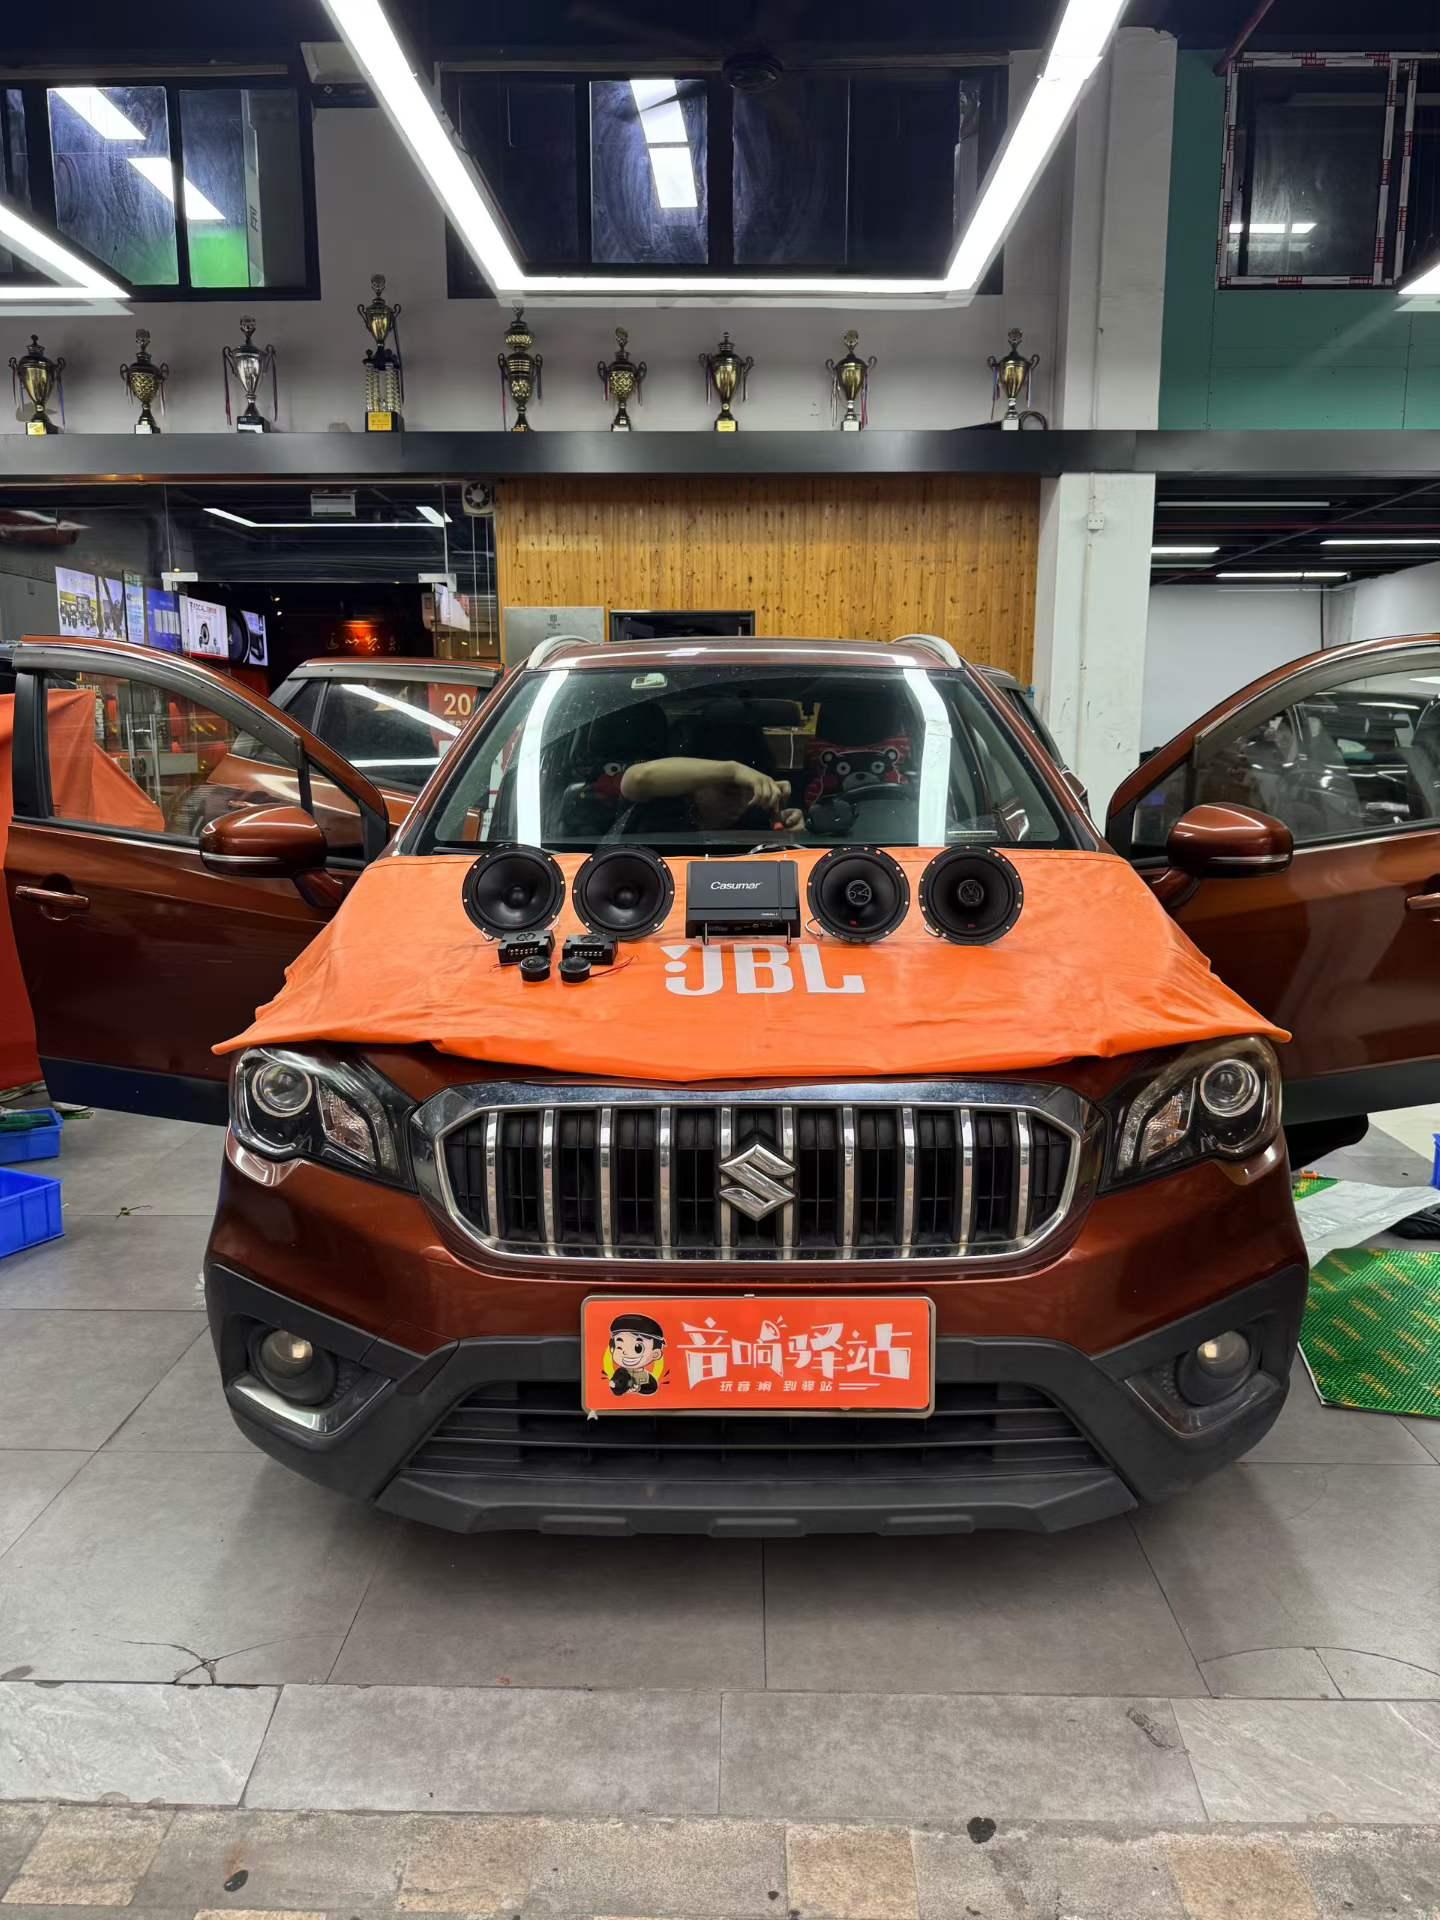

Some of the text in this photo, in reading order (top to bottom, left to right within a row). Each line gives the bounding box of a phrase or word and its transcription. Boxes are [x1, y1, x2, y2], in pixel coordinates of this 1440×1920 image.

[443, 692, 476, 716] 20
[710, 881, 761, 890] Casumar
[664, 943, 865, 995] JBL
[676, 1315, 913, 1390] 音响驿站
